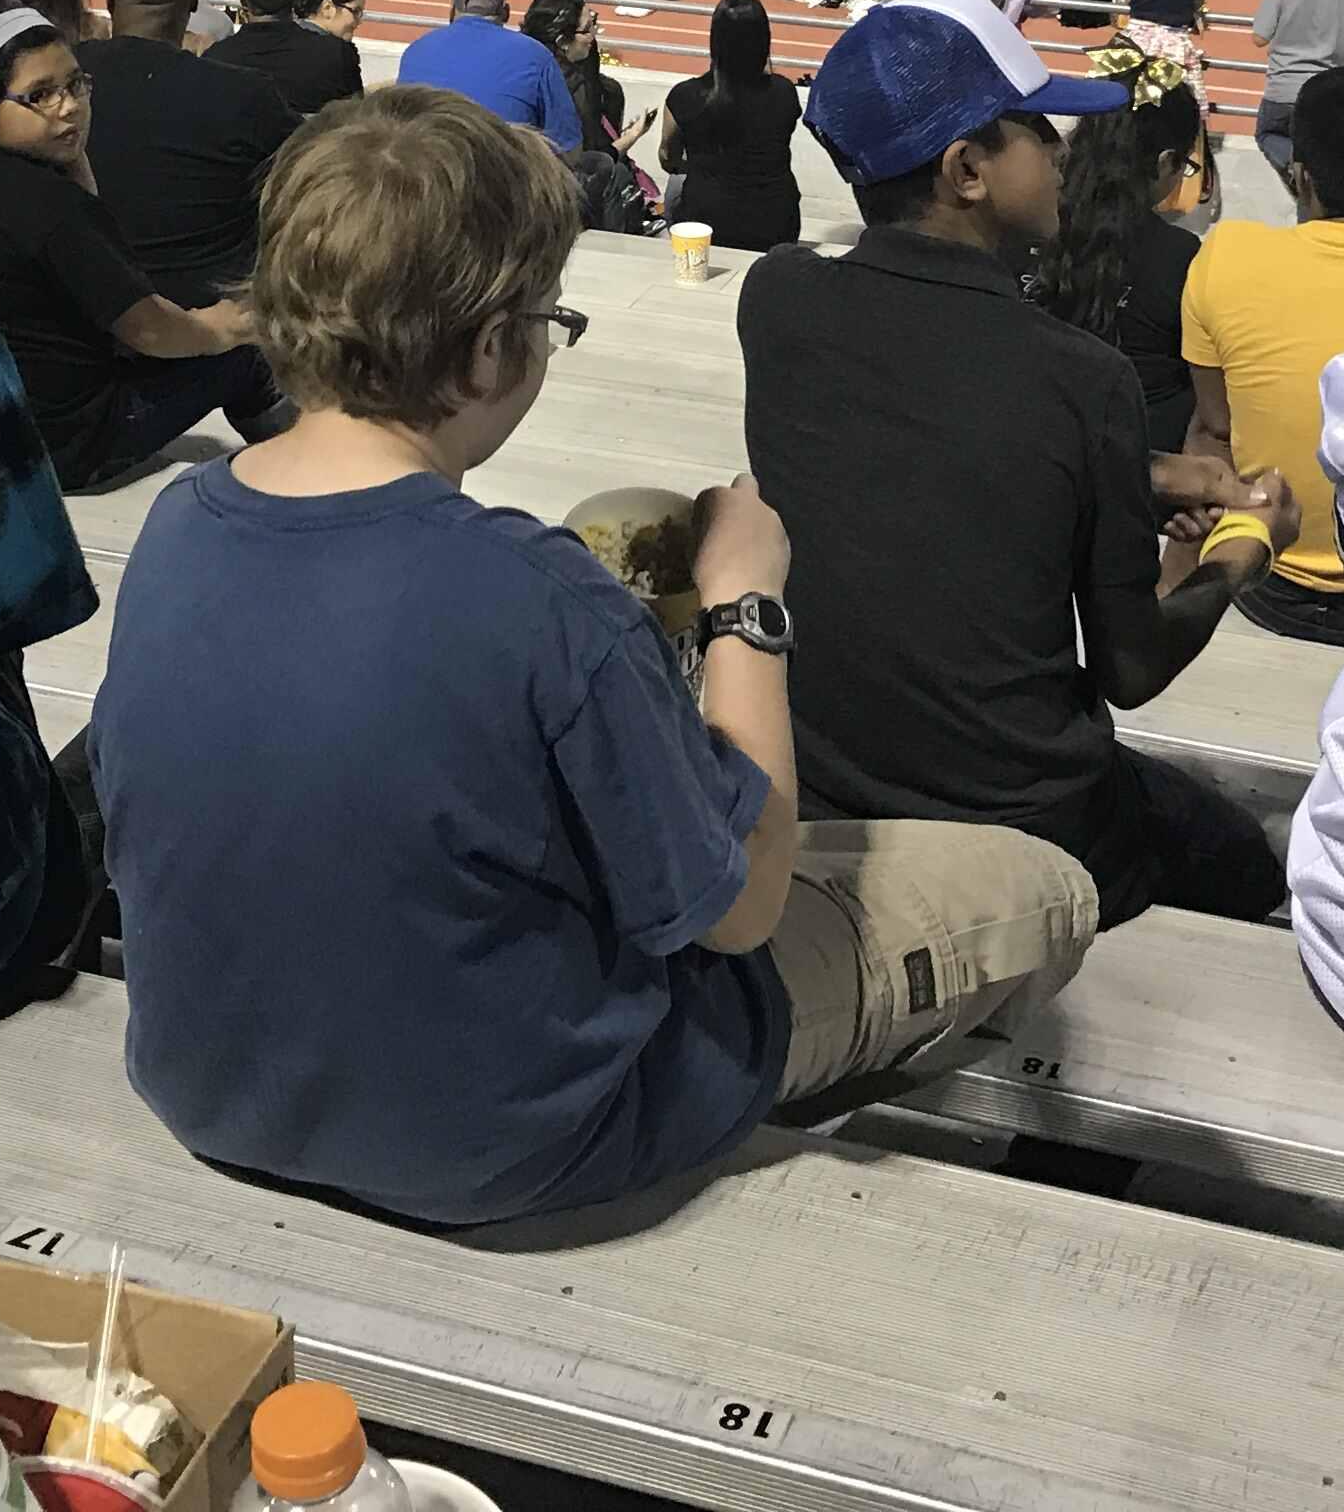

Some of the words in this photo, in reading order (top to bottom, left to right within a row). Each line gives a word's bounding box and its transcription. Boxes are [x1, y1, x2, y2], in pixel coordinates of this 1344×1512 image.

[1022, 1057, 1061, 1080] 18
[5, 1227, 66, 1257] 17
[718, 1402, 775, 1439] 18
